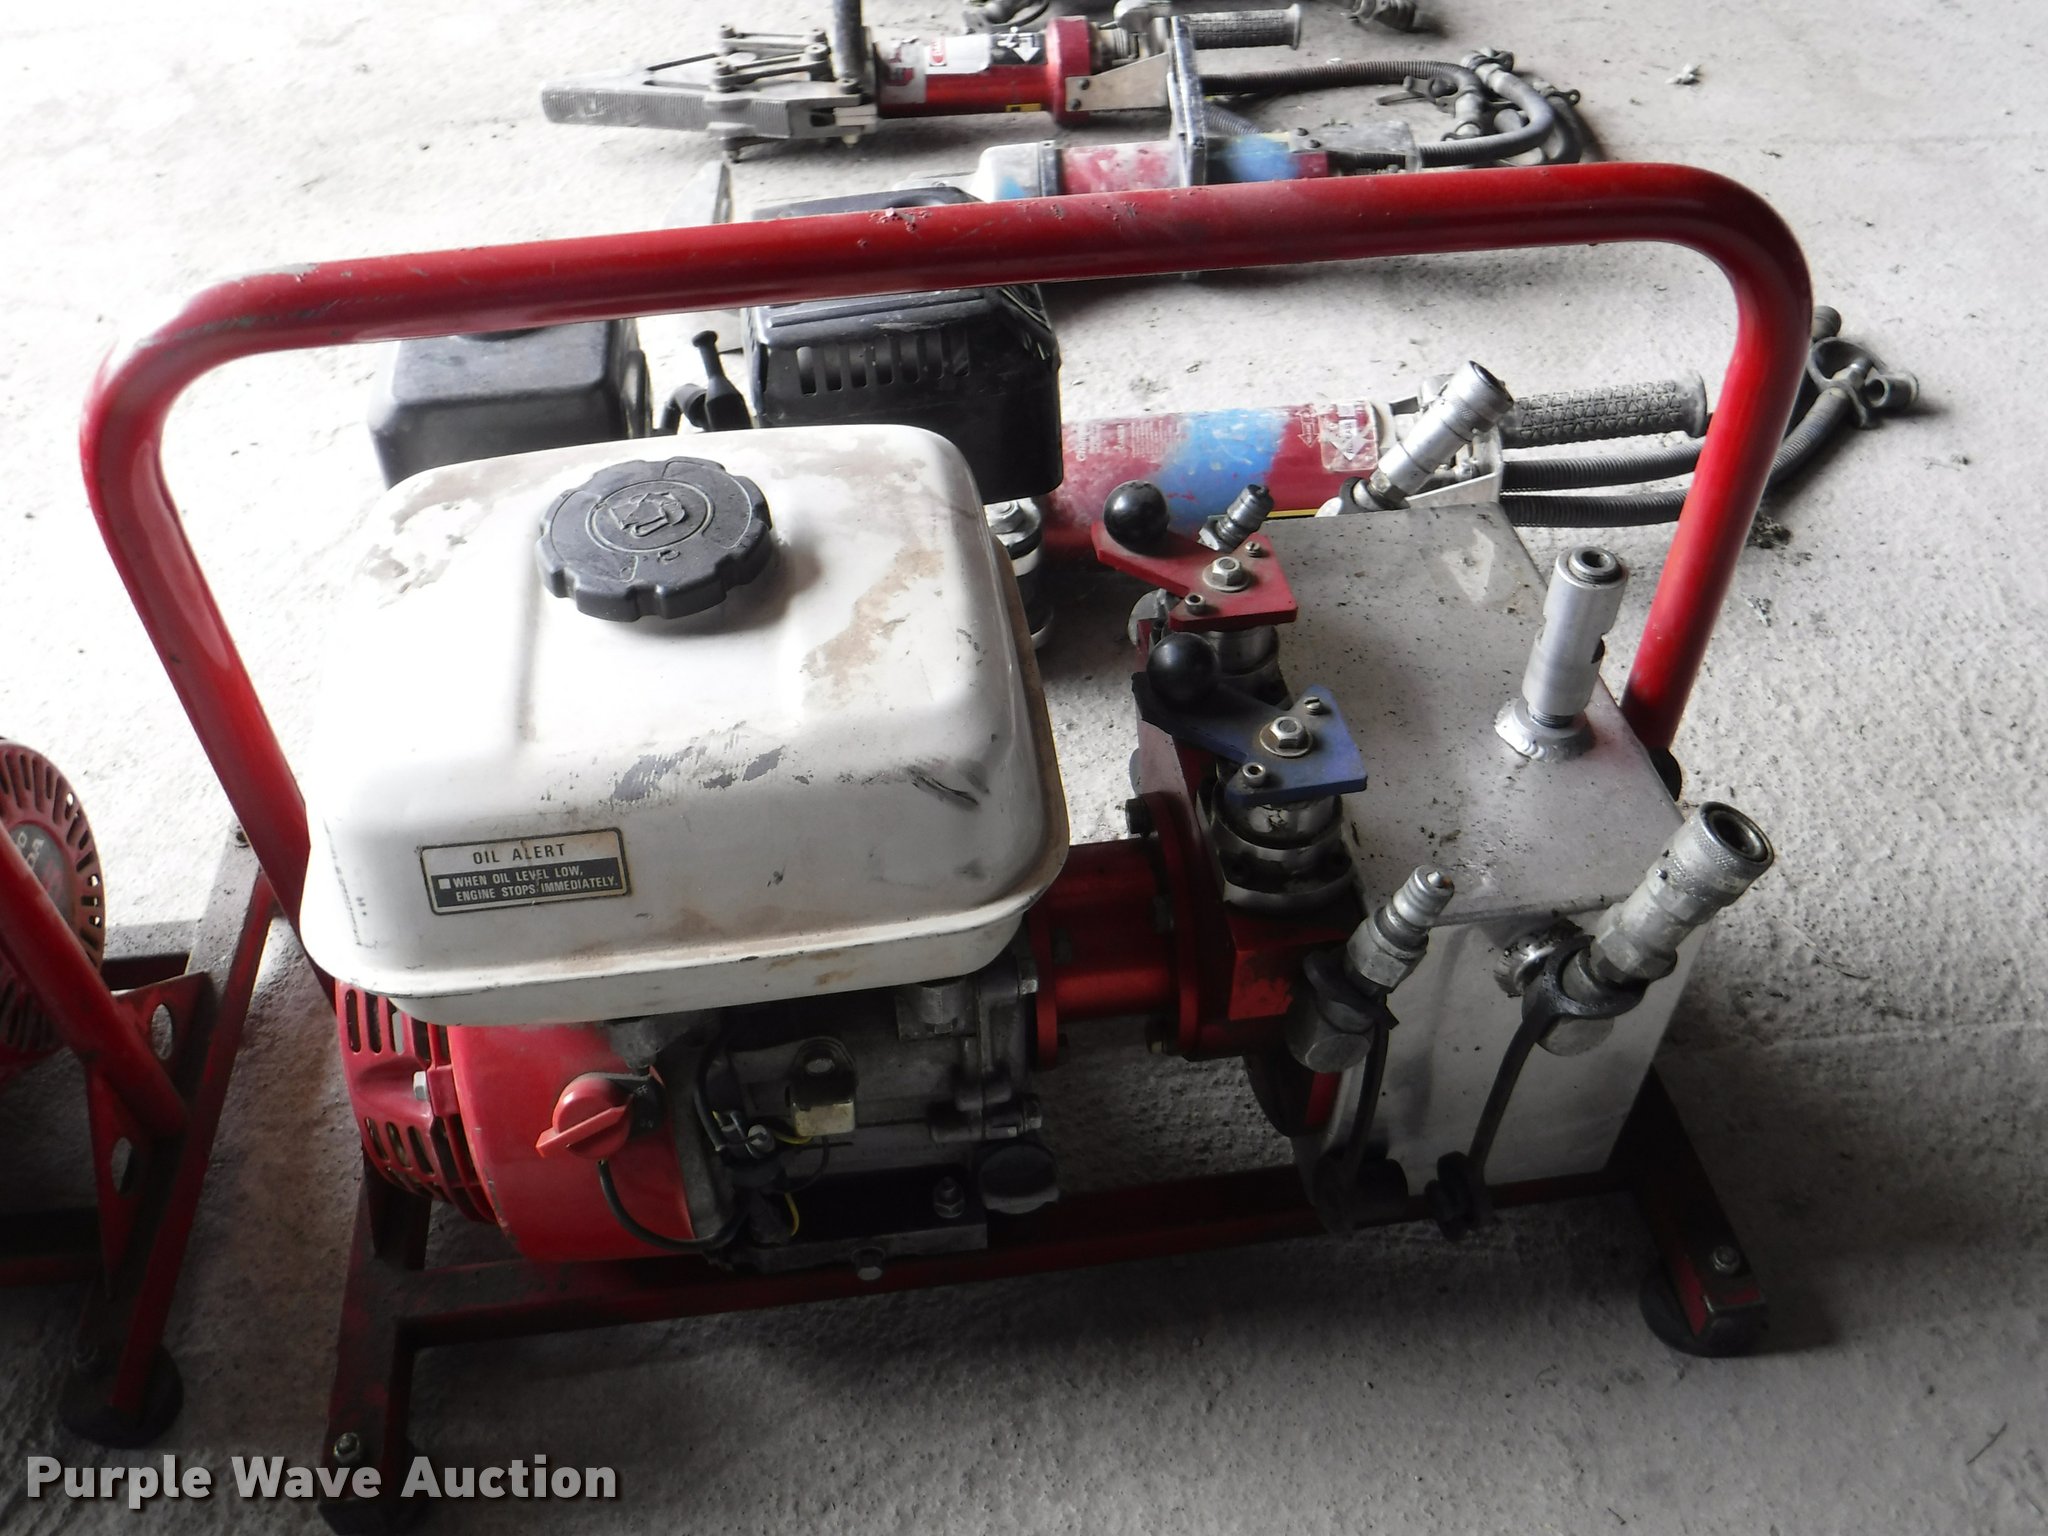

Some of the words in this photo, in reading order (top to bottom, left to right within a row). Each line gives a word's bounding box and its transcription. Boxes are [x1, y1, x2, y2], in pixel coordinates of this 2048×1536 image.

[473, 850, 500, 864] OIL
[512, 843, 565, 861] ALERT
[453, 875, 487, 888] WHEN
[492, 872, 510, 884] OIL
[515, 868, 549, 882] LEVEL
[554, 865, 583, 878] LOW,
[456, 888, 496, 902] ENGINE
[501, 884, 536, 897] STOPS
[541, 876, 618, 893] IMMEDIATELY.
